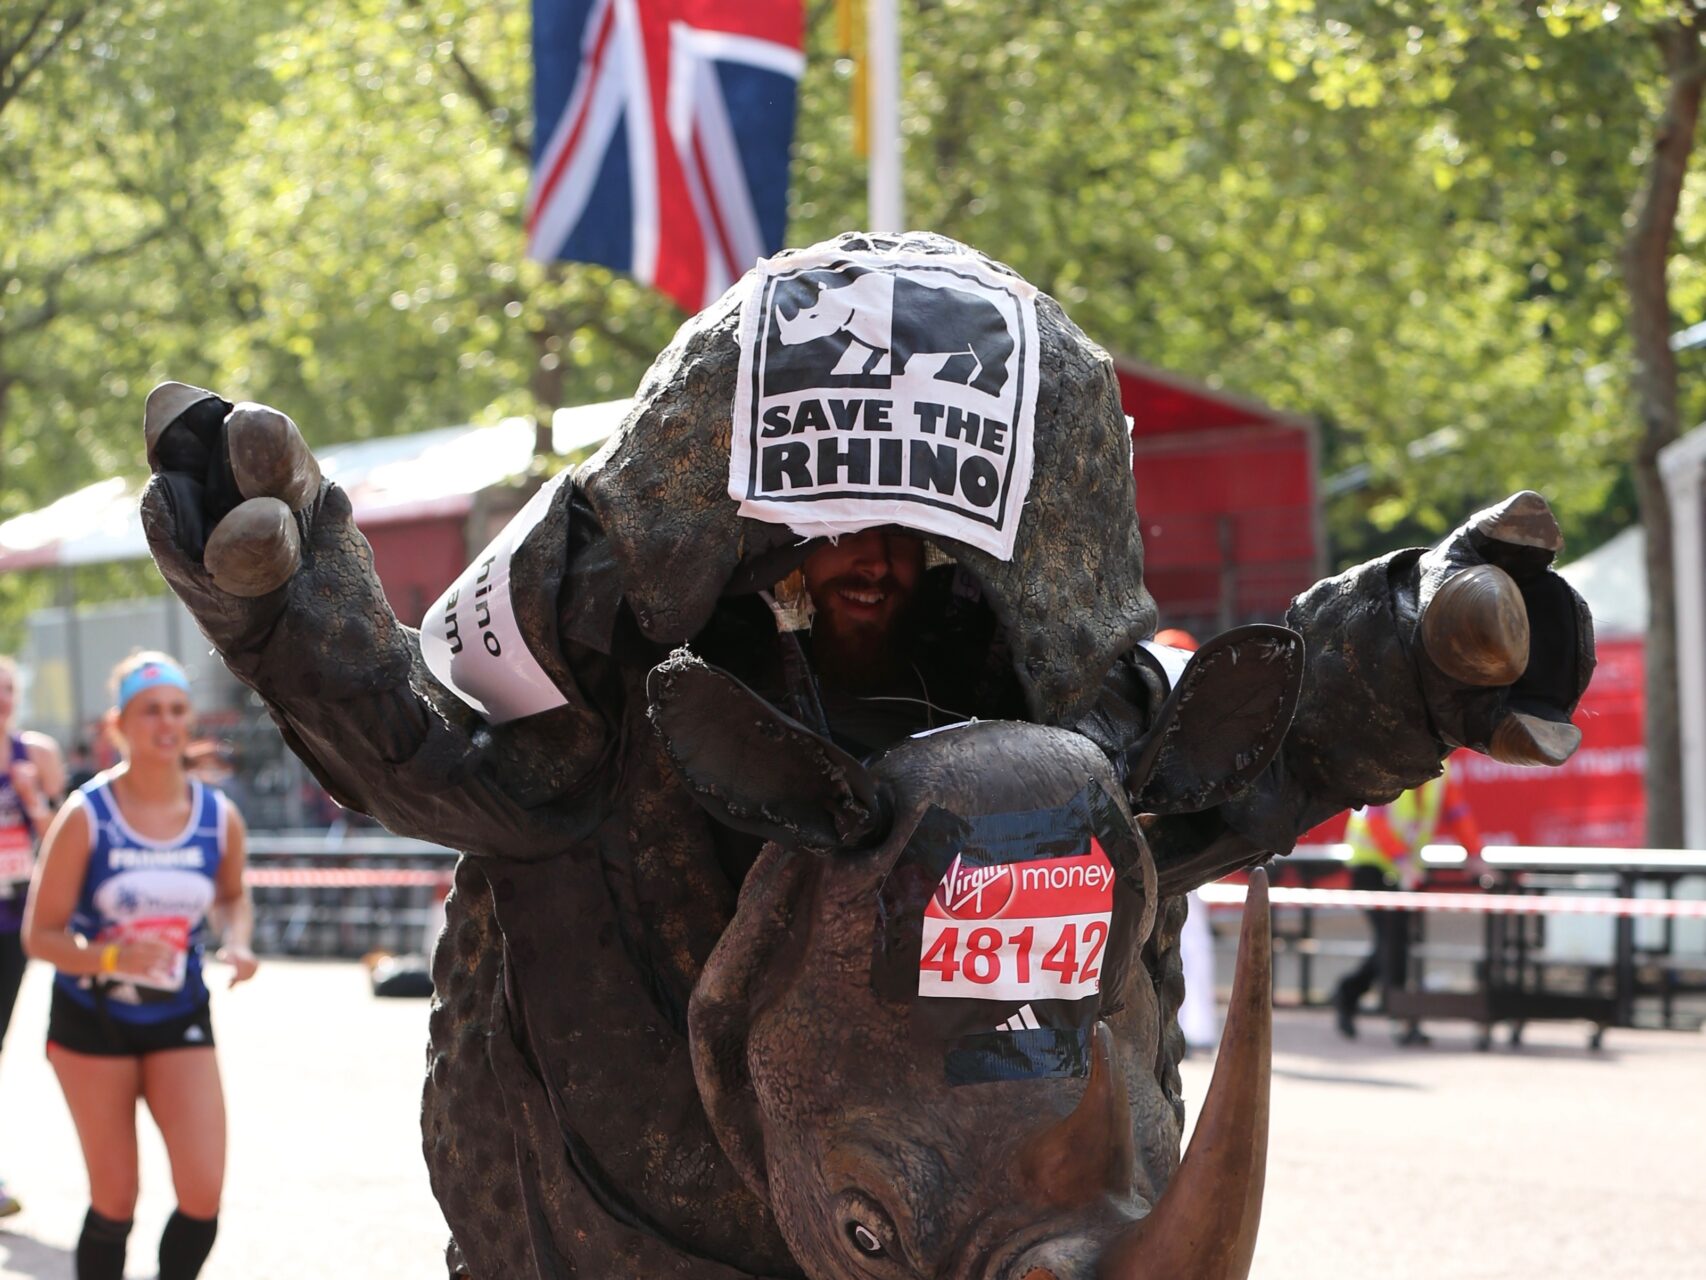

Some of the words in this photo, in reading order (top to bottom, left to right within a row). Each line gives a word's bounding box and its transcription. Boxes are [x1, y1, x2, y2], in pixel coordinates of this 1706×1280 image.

[761, 398, 893, 439] SAVE
[914, 400, 1008, 456] THE
[760, 436, 1000, 509] RHINO
[1021, 864, 1115, 893] money
[919, 920, 1109, 985] 48142
